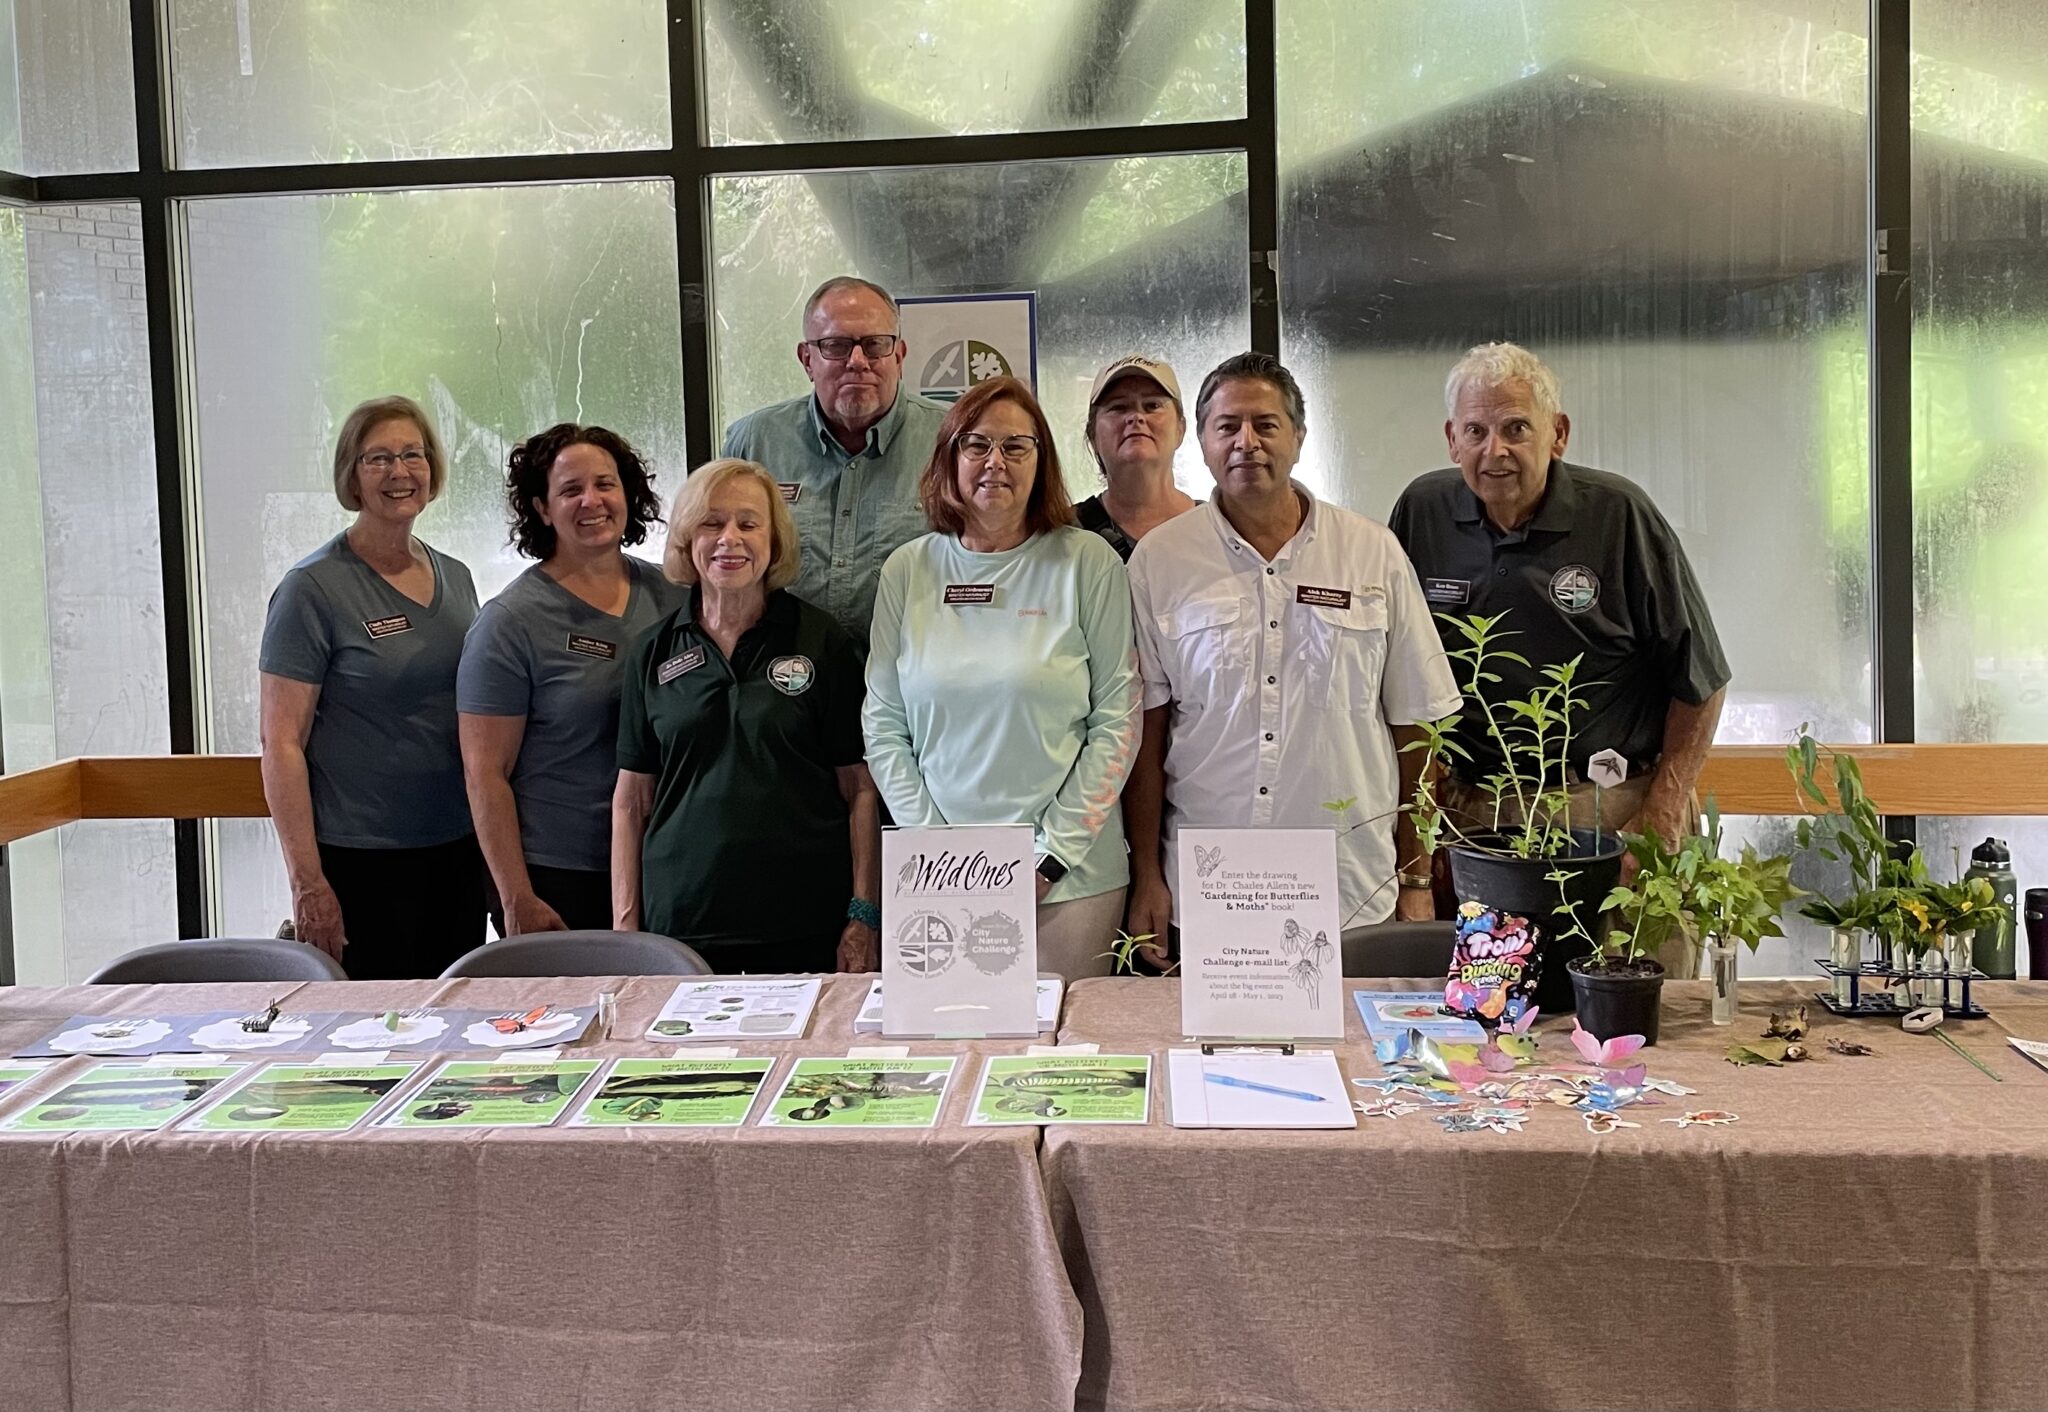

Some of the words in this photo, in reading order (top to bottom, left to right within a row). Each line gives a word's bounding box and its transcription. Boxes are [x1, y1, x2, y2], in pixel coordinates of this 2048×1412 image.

[912, 850, 970, 894] Wild
[964, 850, 1022, 891] Ones
[1221, 871, 1244, 879] Enter
[1246, 871, 1261, 879] the
[1262, 871, 1298, 881] drawing
[1201, 881, 1214, 890] for
[1232, 881, 1265, 890] Charles
[1266, 881, 1296, 890] Allen's
[1200, 891, 1254, 902] "Gardening
[1255, 891, 1268, 900] for
[1270, 891, 1320, 900] Butterflies
[1226, 902, 1234, 911] &
[1235, 902, 1269, 911] Moths"
[1271, 902, 1295, 911] book!
[971, 929, 991, 938] City
[978, 937, 1010, 945] Nature
[1466, 929, 1529, 958] Trolli
[971, 945, 1017, 955] Challenge
[1222, 947, 1239, 956] City
[1240, 947, 1270, 955] Nature
[1202, 958, 1244, 967] Challenge
[1245, 958, 1273, 966] e-mail
[1460, 961, 1522, 984] Bursting
[1230, 982, 1241, 990] the
